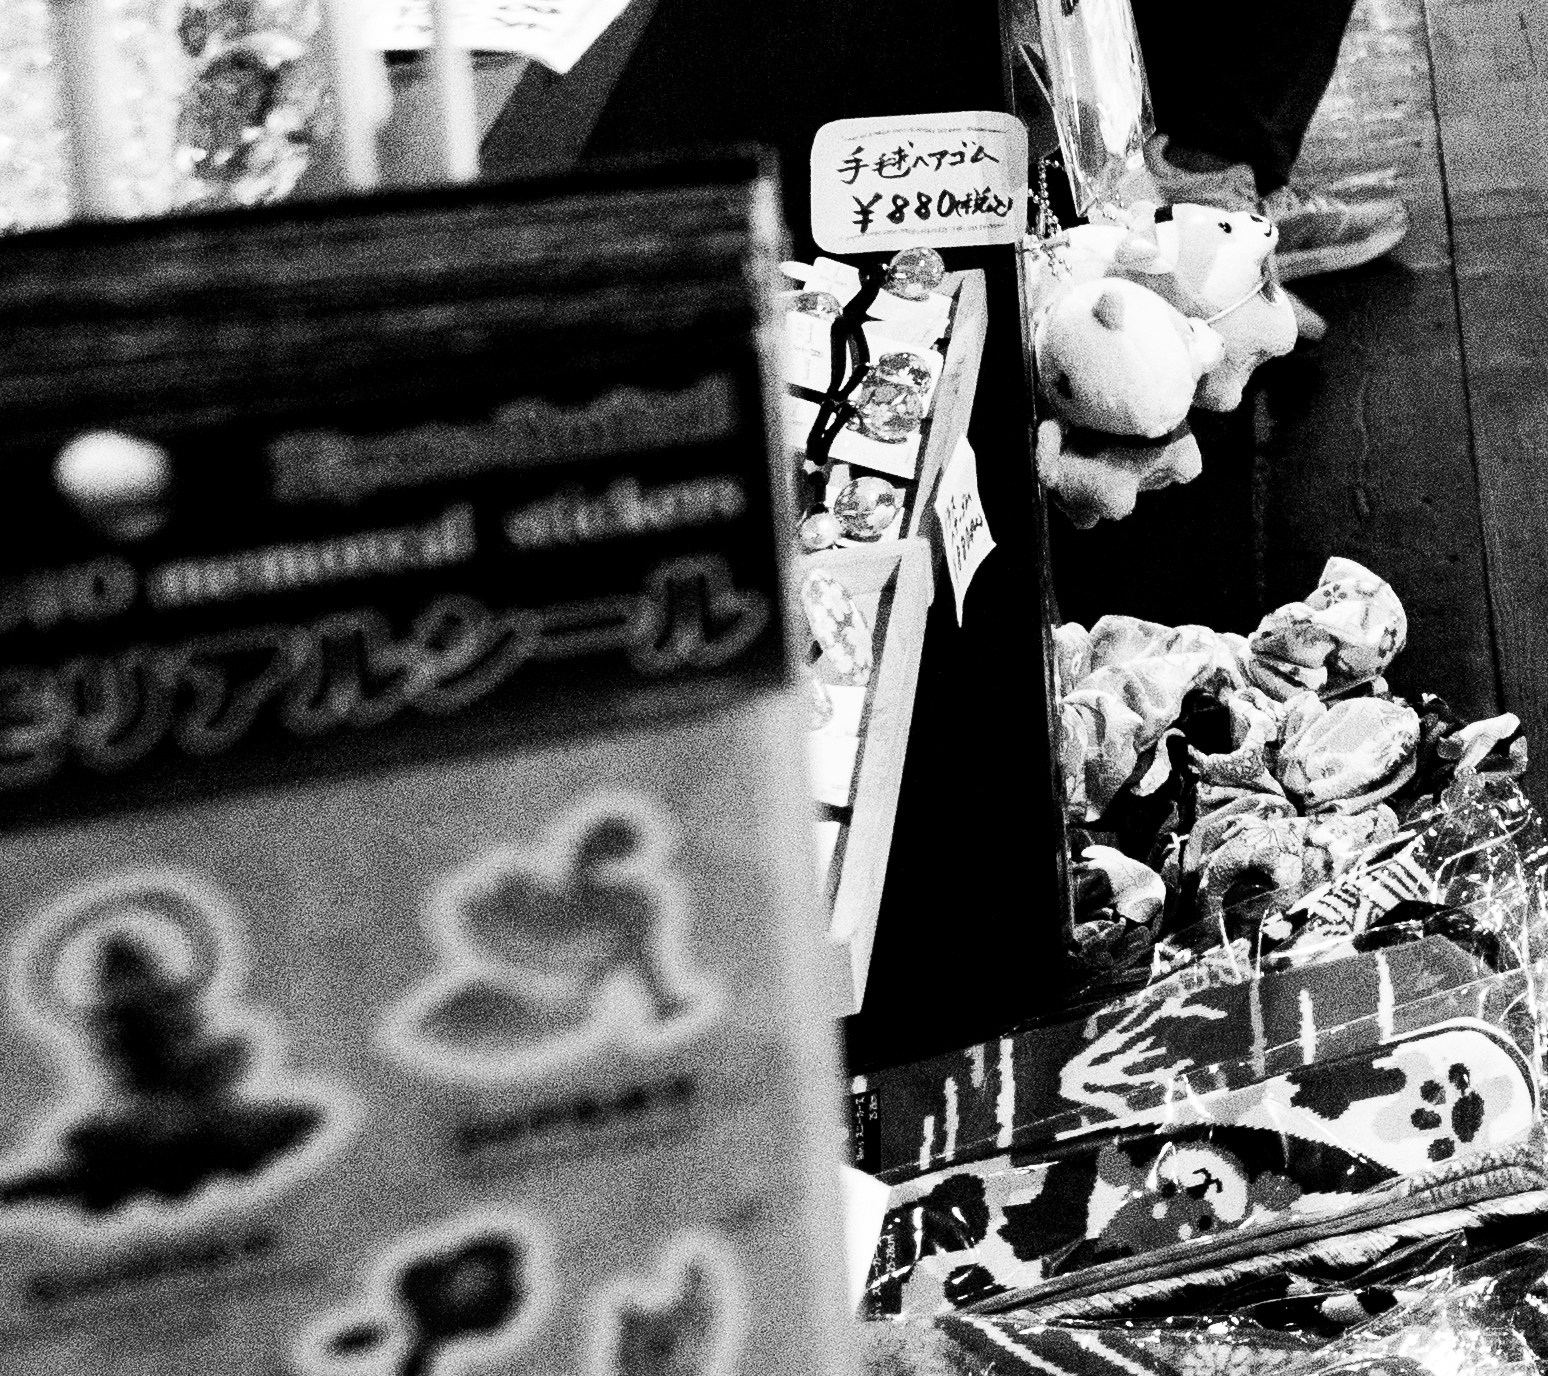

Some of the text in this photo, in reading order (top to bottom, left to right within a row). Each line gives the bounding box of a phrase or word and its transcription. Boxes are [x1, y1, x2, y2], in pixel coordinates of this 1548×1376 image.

[836, 140, 1000, 186] 手毬ヘアゴム
